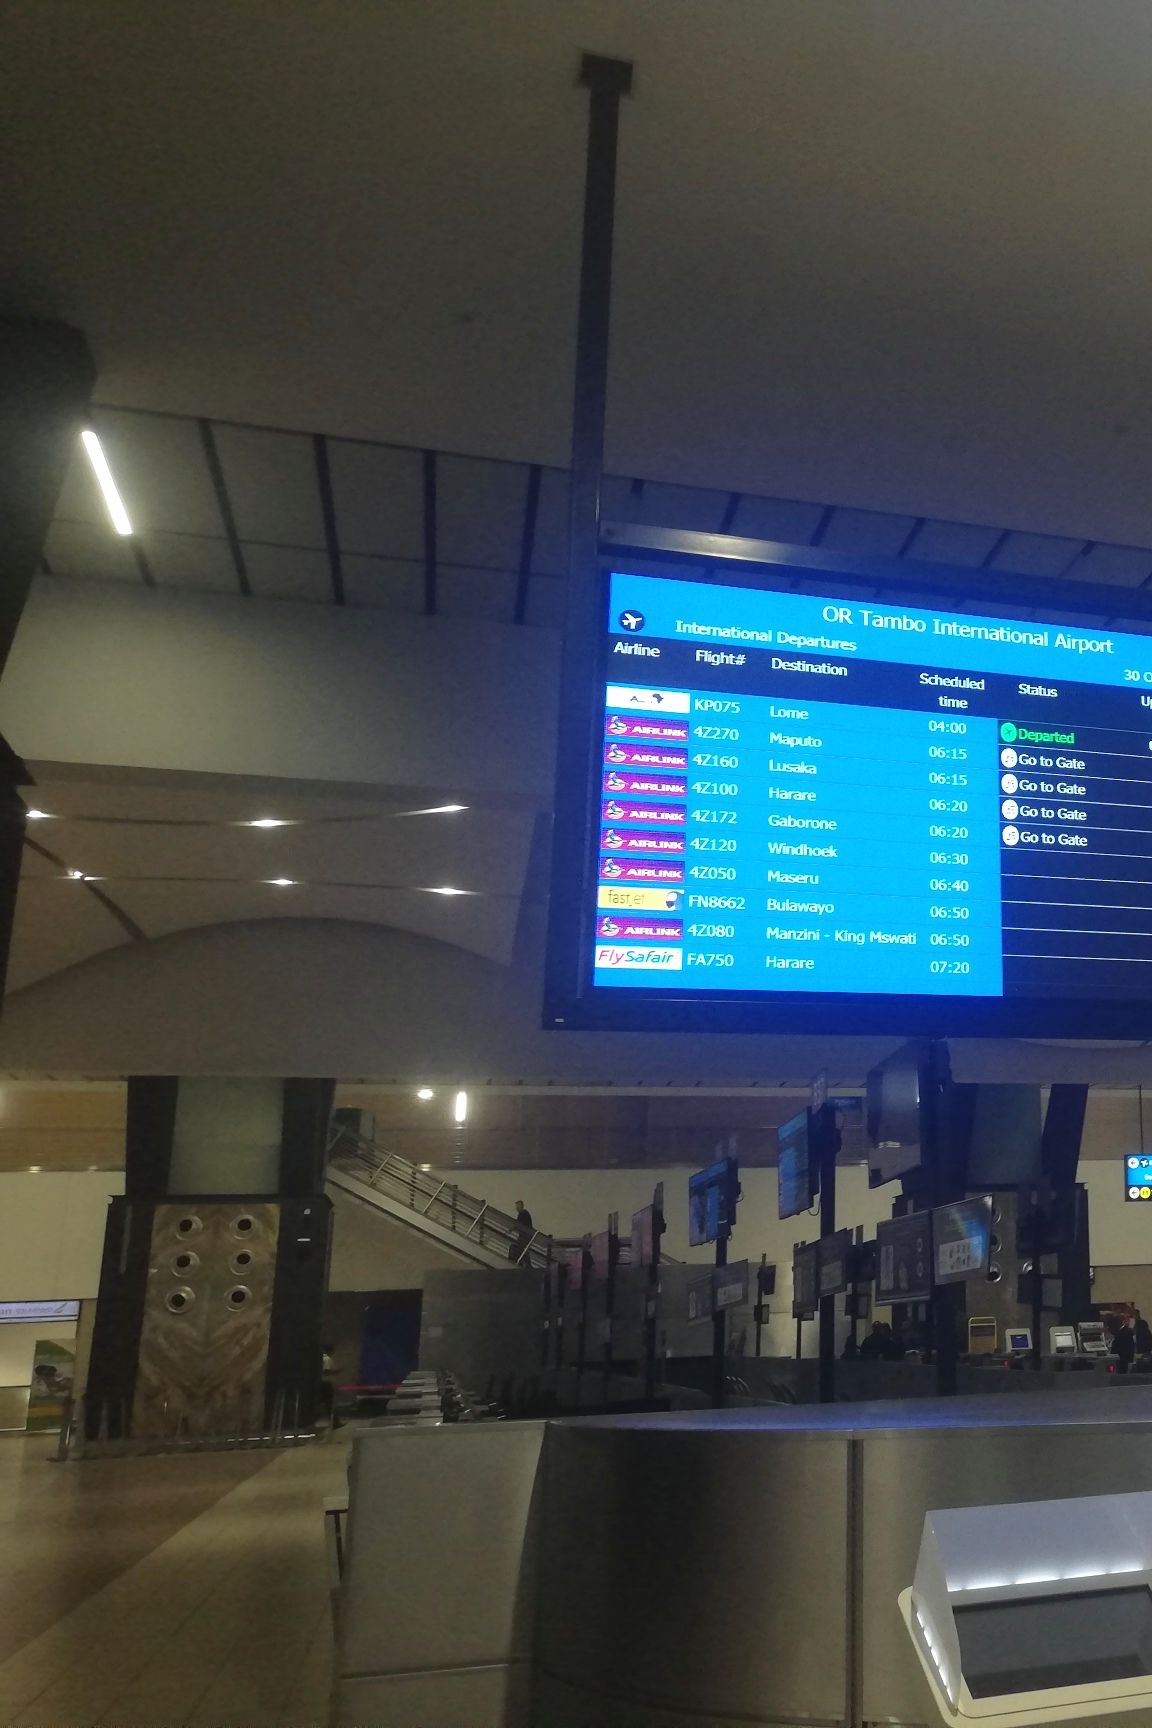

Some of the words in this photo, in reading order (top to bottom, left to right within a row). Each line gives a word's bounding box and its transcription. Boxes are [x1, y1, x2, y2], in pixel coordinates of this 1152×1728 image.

[675, 620, 772, 642] International
[777, 631, 858, 652] Departures
[822, 606, 853, 624] OR
[859, 609, 926, 633] Tambo
[932, 618, 1048, 648] International
[1054, 633, 1113, 654] Airport
[613, 642, 661, 657] Airline
[696, 650, 748, 667] Flight#
[771, 658, 848, 677] Destination
[920, 672, 984, 689] Scheduled
[1018, 682, 1058, 698] Status
[1124, 669, 1141, 681] 30
[937, 696, 968, 709] time
[695, 699, 740, 713] KP075
[769, 706, 809, 720] Lome
[928, 720, 967, 734] 04:00
[1019, 729, 1074, 743] Departed
[693, 726, 739, 740] 4Z270
[770, 732, 824, 748] Maputo
[928, 746, 968, 759] 06:15
[1019, 754, 1036, 766] Go
[1040, 756, 1054, 768] to
[1056, 757, 1085, 769] Gate
[692, 754, 740, 768] 4Z160
[768, 759, 817, 776] Lusaka
[928, 772, 968, 786] 06:15
[1019, 780, 1039, 792] Go
[1040, 782, 1053, 792] to
[1057, 782, 1086, 795] Gate
[691, 782, 740, 796] 4Z100
[768, 787, 816, 801] Harare
[928, 799, 968, 813] 06:20
[1020, 806, 1038, 817] Go
[1039, 807, 1055, 819] to
[1057, 808, 1087, 821] Gate
[691, 810, 738, 825] 4Z172
[768, 815, 838, 830] Gaborone
[929, 825, 969, 838] 06:20
[1021, 832, 1038, 844] Go
[1041, 833, 1055, 845] to
[1057, 834, 1088, 847] Gate
[690, 838, 737, 852] 4Z120
[768, 842, 838, 858] Windhoek
[929, 852, 968, 865] 06:30
[689, 865, 736, 880] 4Z050
[767, 870, 820, 884] Maseru
[930, 879, 969, 893] 06:40
[689, 895, 745, 910] FN8662
[766, 898, 835, 915] Bulawayo
[929, 906, 969, 919] 06:50
[687, 924, 735, 939] 4Z080
[766, 927, 822, 941] Manzini
[834, 930, 865, 945] King
[868, 931, 916, 944] Mswati
[930, 933, 972, 946] 06:50
[599, 949, 674, 965] FlySafair
[687, 953, 735, 966] FA750
[766, 956, 814, 969] Harare
[929, 961, 971, 974] 07:20
